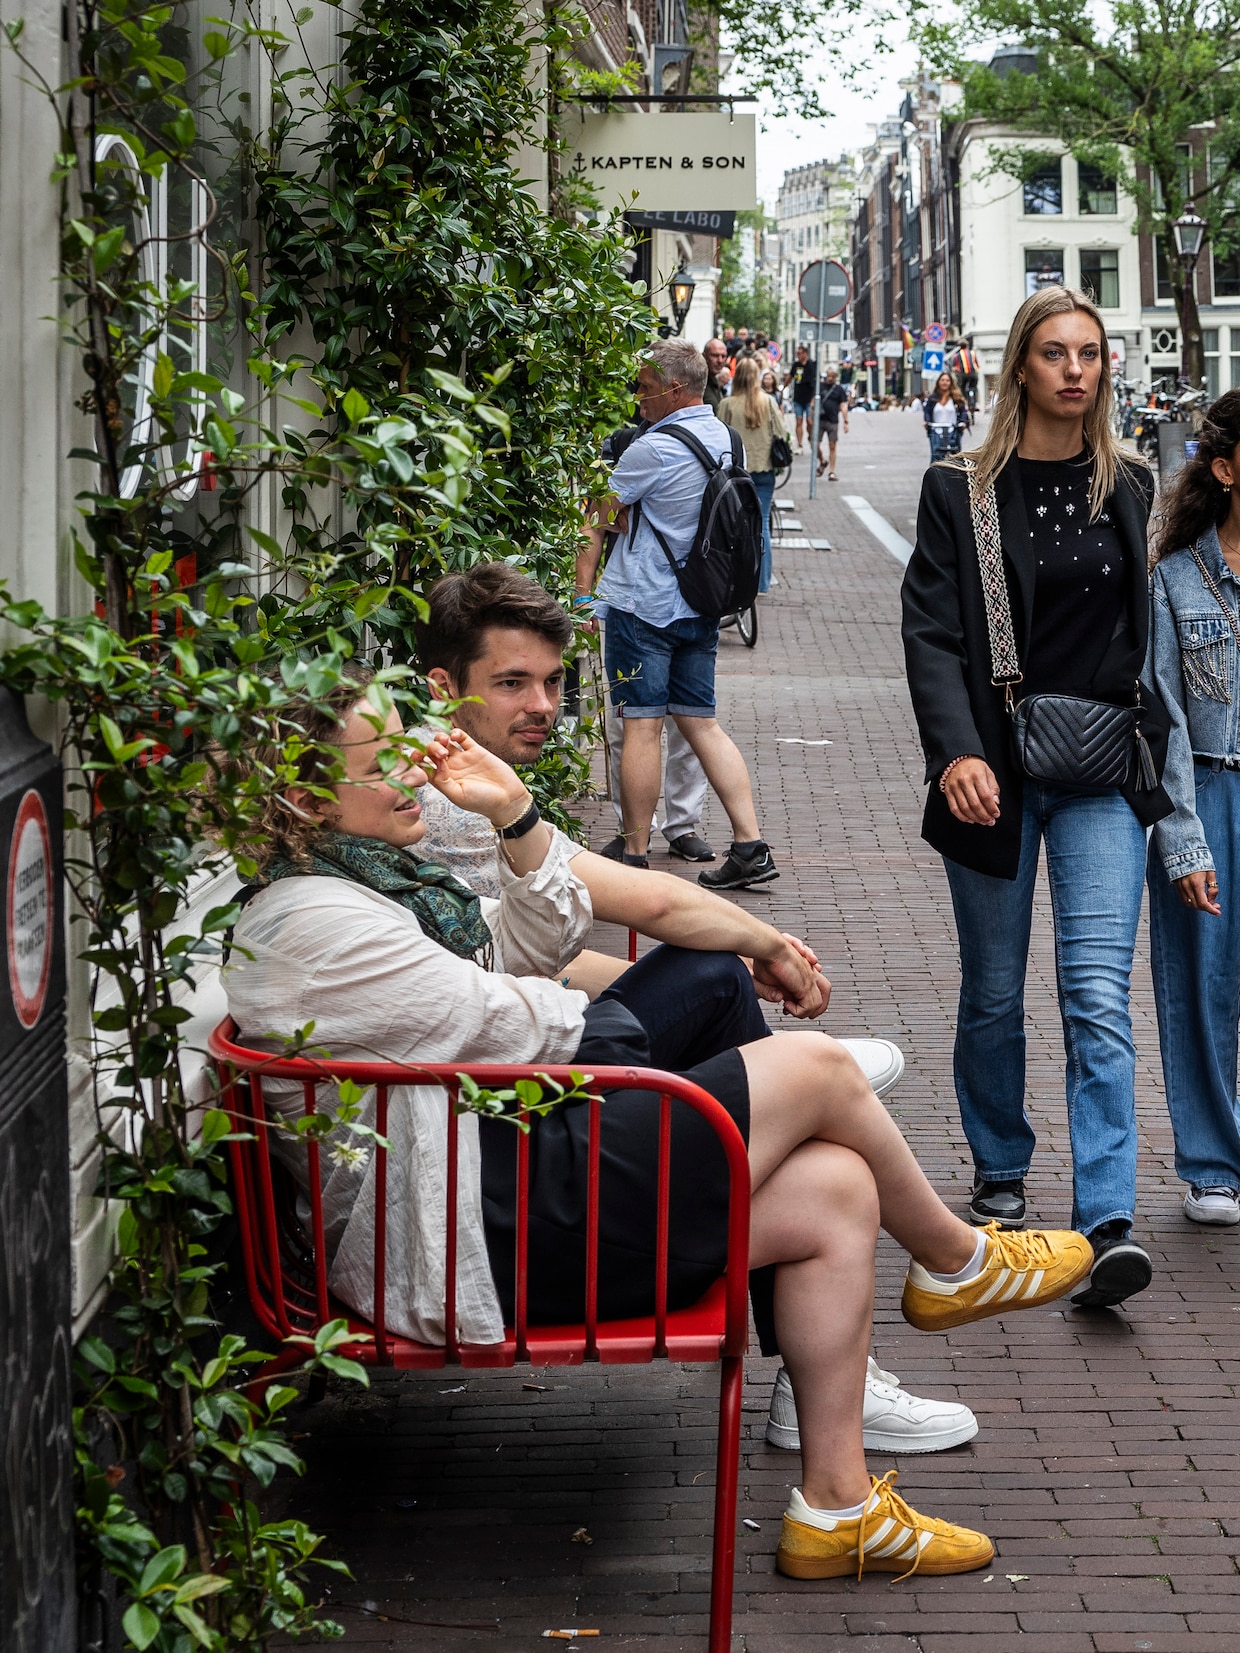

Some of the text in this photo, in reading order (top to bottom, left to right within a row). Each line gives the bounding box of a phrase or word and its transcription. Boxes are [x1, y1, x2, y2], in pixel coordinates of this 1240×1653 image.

[591, 156, 746, 169] KAPTEN & SON
[673, 210, 721, 229] LABO
